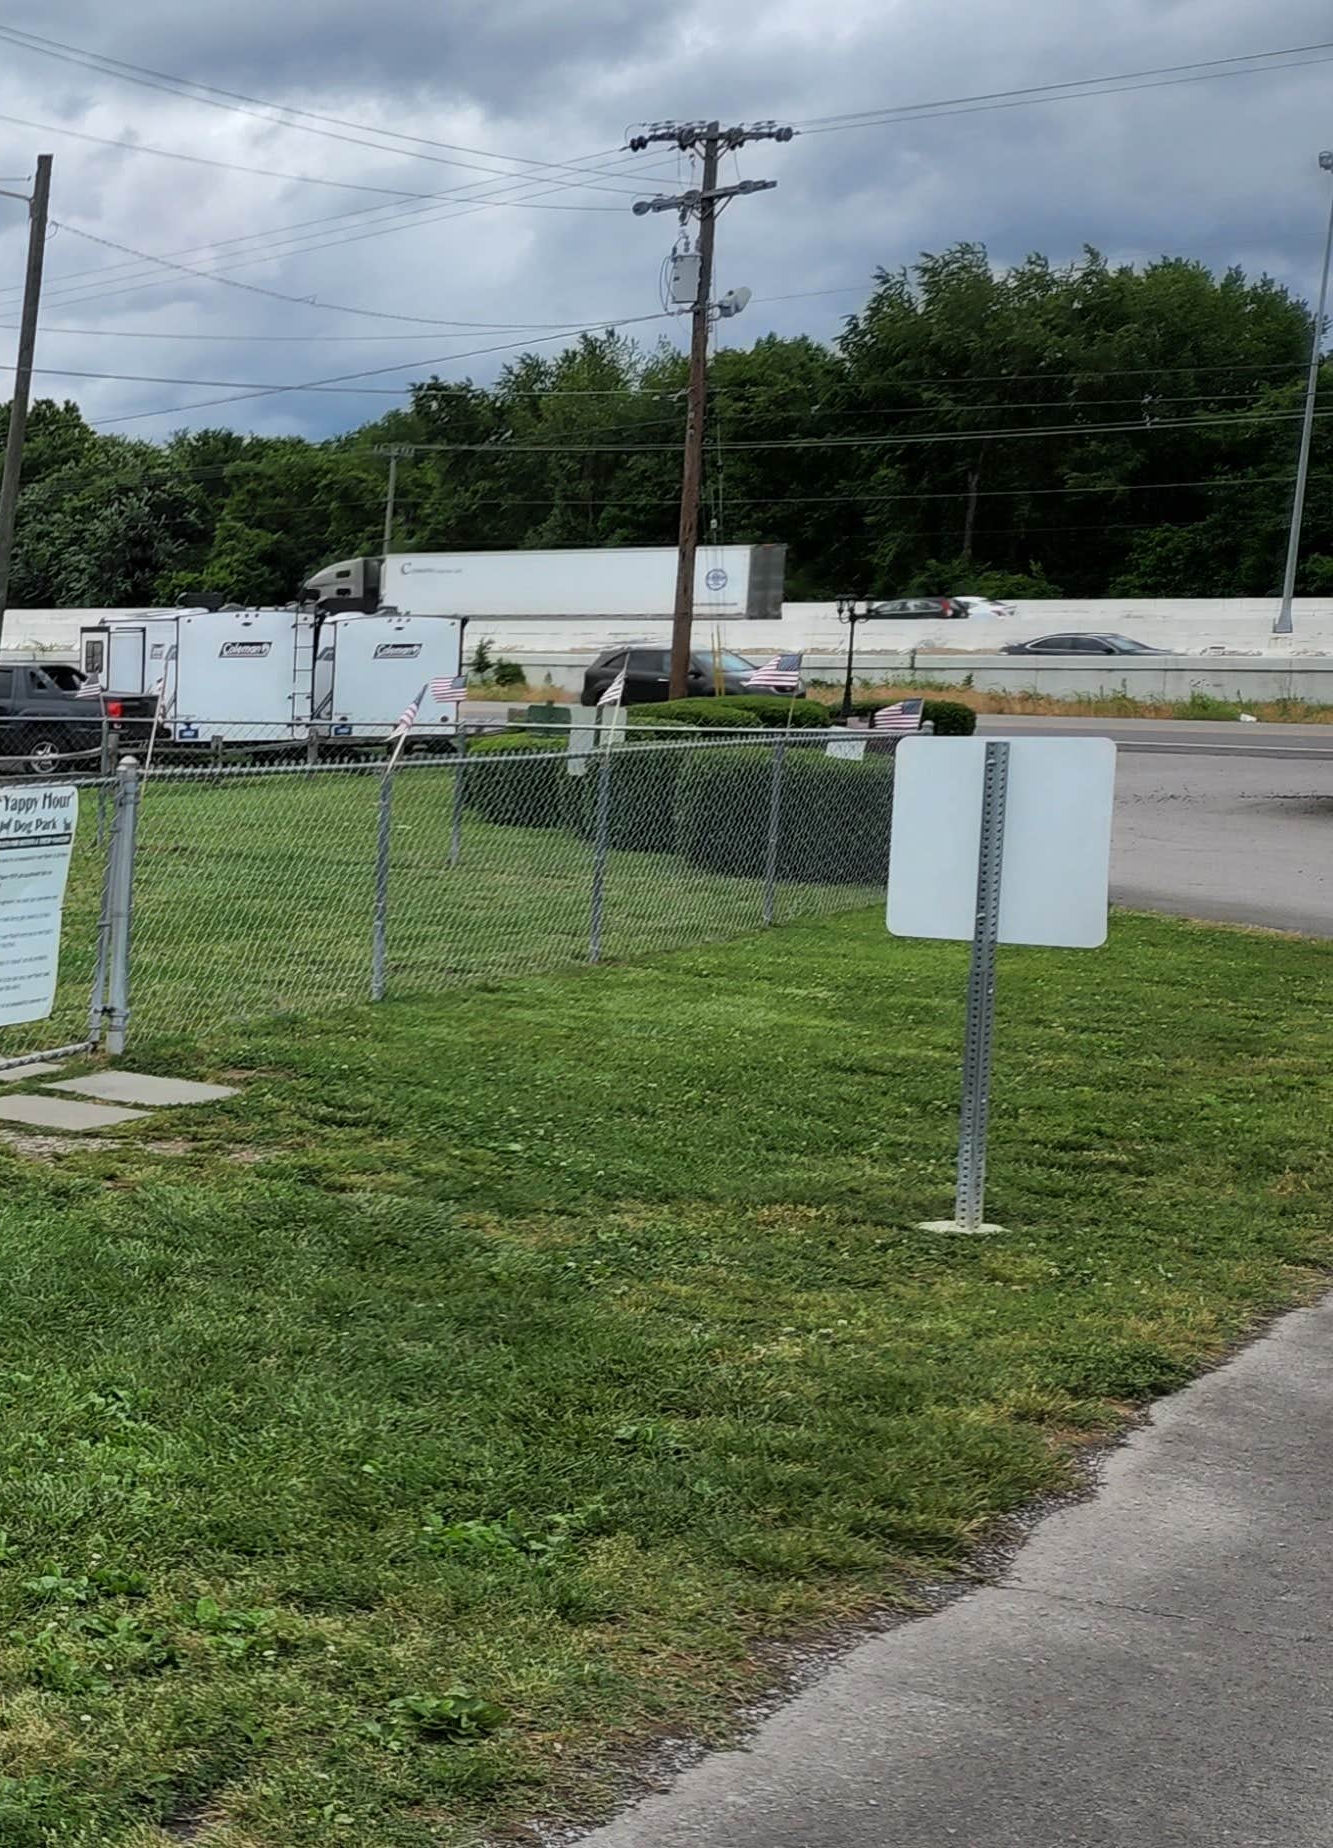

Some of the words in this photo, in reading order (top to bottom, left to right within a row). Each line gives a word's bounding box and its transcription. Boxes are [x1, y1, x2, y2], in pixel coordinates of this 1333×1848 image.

[223, 642, 263, 656] Coleman
[13, 819, 34, 834] Dog
[35, 818, 57, 831] Park
